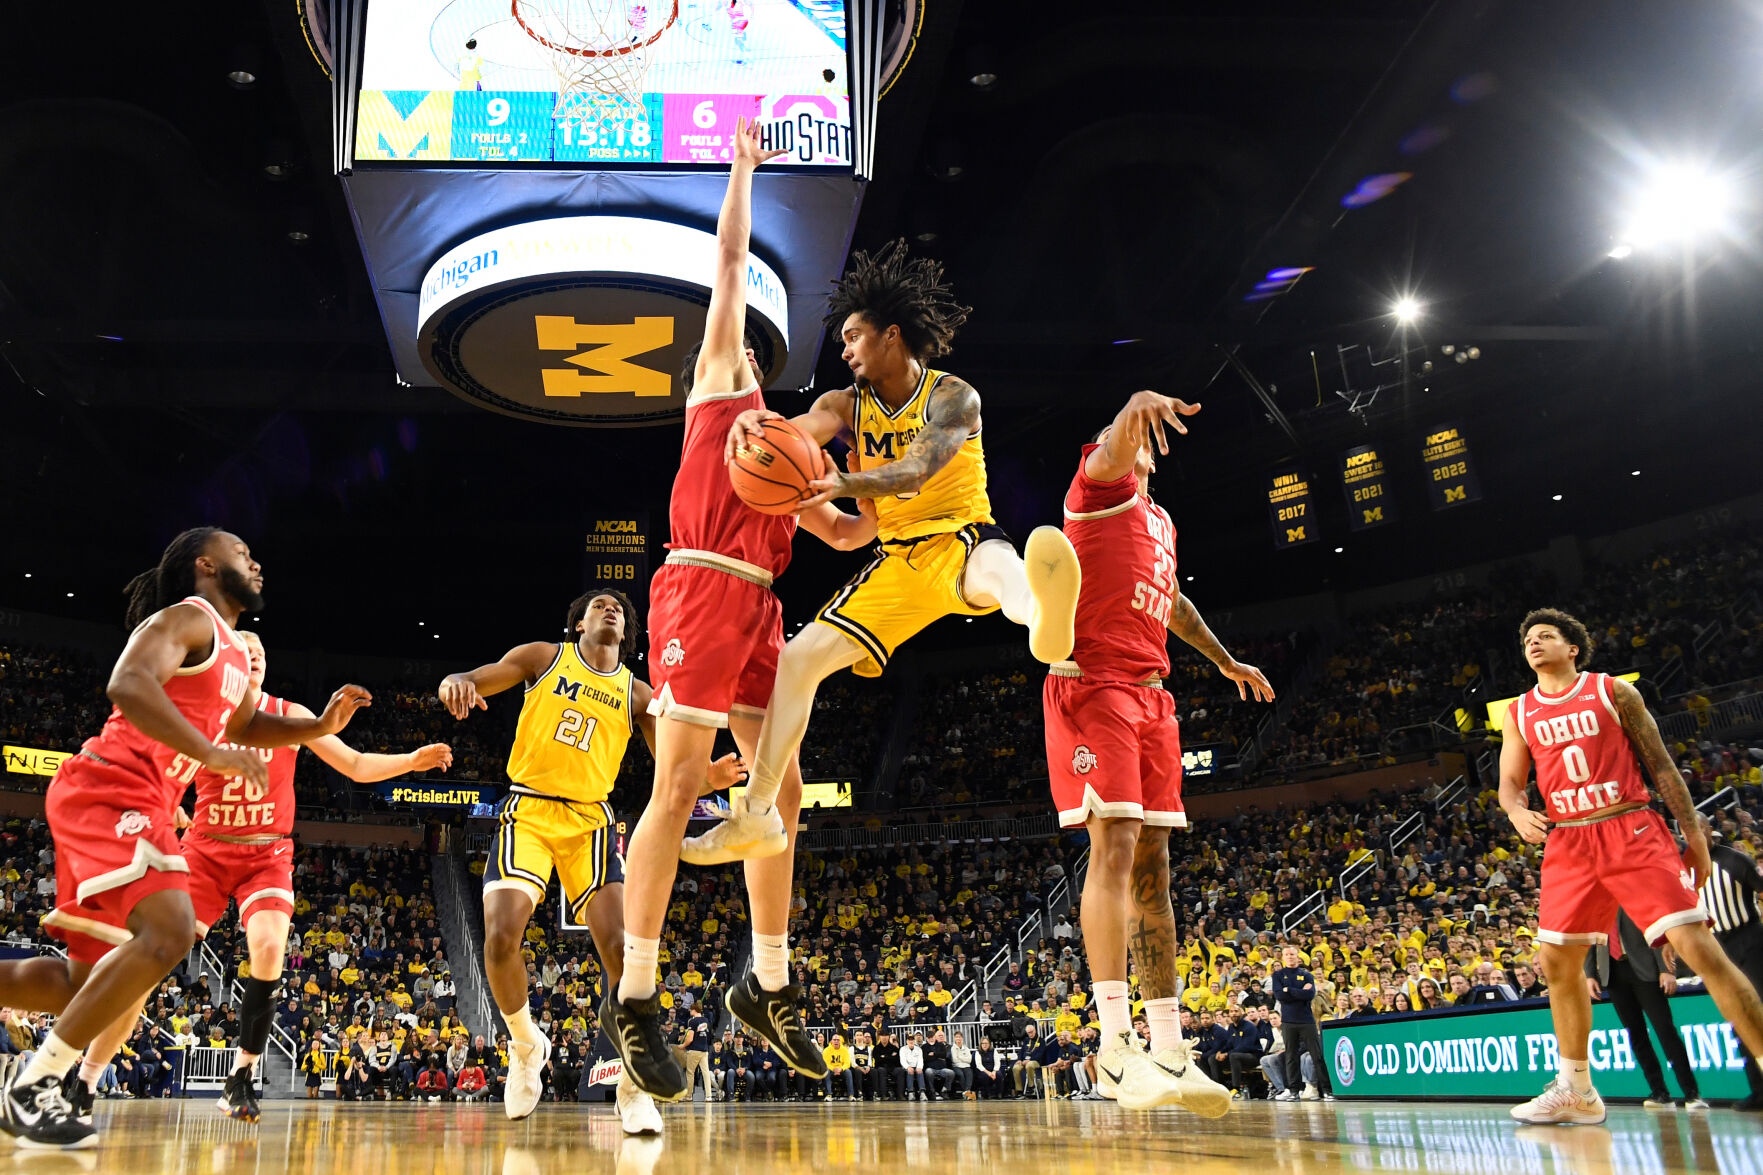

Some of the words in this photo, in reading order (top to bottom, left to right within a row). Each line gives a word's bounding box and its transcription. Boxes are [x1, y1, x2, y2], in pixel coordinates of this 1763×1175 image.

[486, 98, 510, 126] 9
[692, 101, 717, 128] 6
[471, 133, 508, 144] FOULS
[519, 133, 527, 143] 2
[558, 121, 651, 146] 15:18
[681, 135, 721, 146] FOULS
[798, 113, 850, 162] STAT
[480, 147, 504, 157] TOL
[509, 147, 518, 157] 4
[690, 149, 715, 159] TOL
[720, 148, 730, 158] 4
[535, 315, 675, 397] M
[1427, 429, 1458, 446] NCAA
[1346, 451, 1377, 468] NCAA
[1433, 461, 1467, 481] 2022
[1354, 484, 1383, 502] 2021
[1444, 486, 1466, 503] M
[1278, 504, 1306, 521] 2017
[1363, 507, 1383, 524] M
[595, 520, 637, 533] NCAA
[1286, 526, 1306, 542] M
[586, 534, 646, 545] CHAMPIONS
[596, 564, 635, 580] 1989
[1131, 580, 1173, 628] STAT
[553, 675, 622, 711] MICHIGAN
[553, 708, 597, 752] 21
[1533, 709, 1600, 746] OHIO
[9, 752, 60, 771] NIS
[1562, 745, 1591, 783] 0
[392, 787, 480, 804] #CrislerLIVE
[1550, 780, 1621, 814] STATE
[208, 802, 275, 827] STATE
[1363, 1044, 1400, 1075] OLD
[1404, 1035, 1519, 1074] DOMINION
[1524, 1028, 1636, 1070] FRGH
[1667, 1022, 1746, 1069] INE
[590, 1065, 622, 1085] LIBMA
